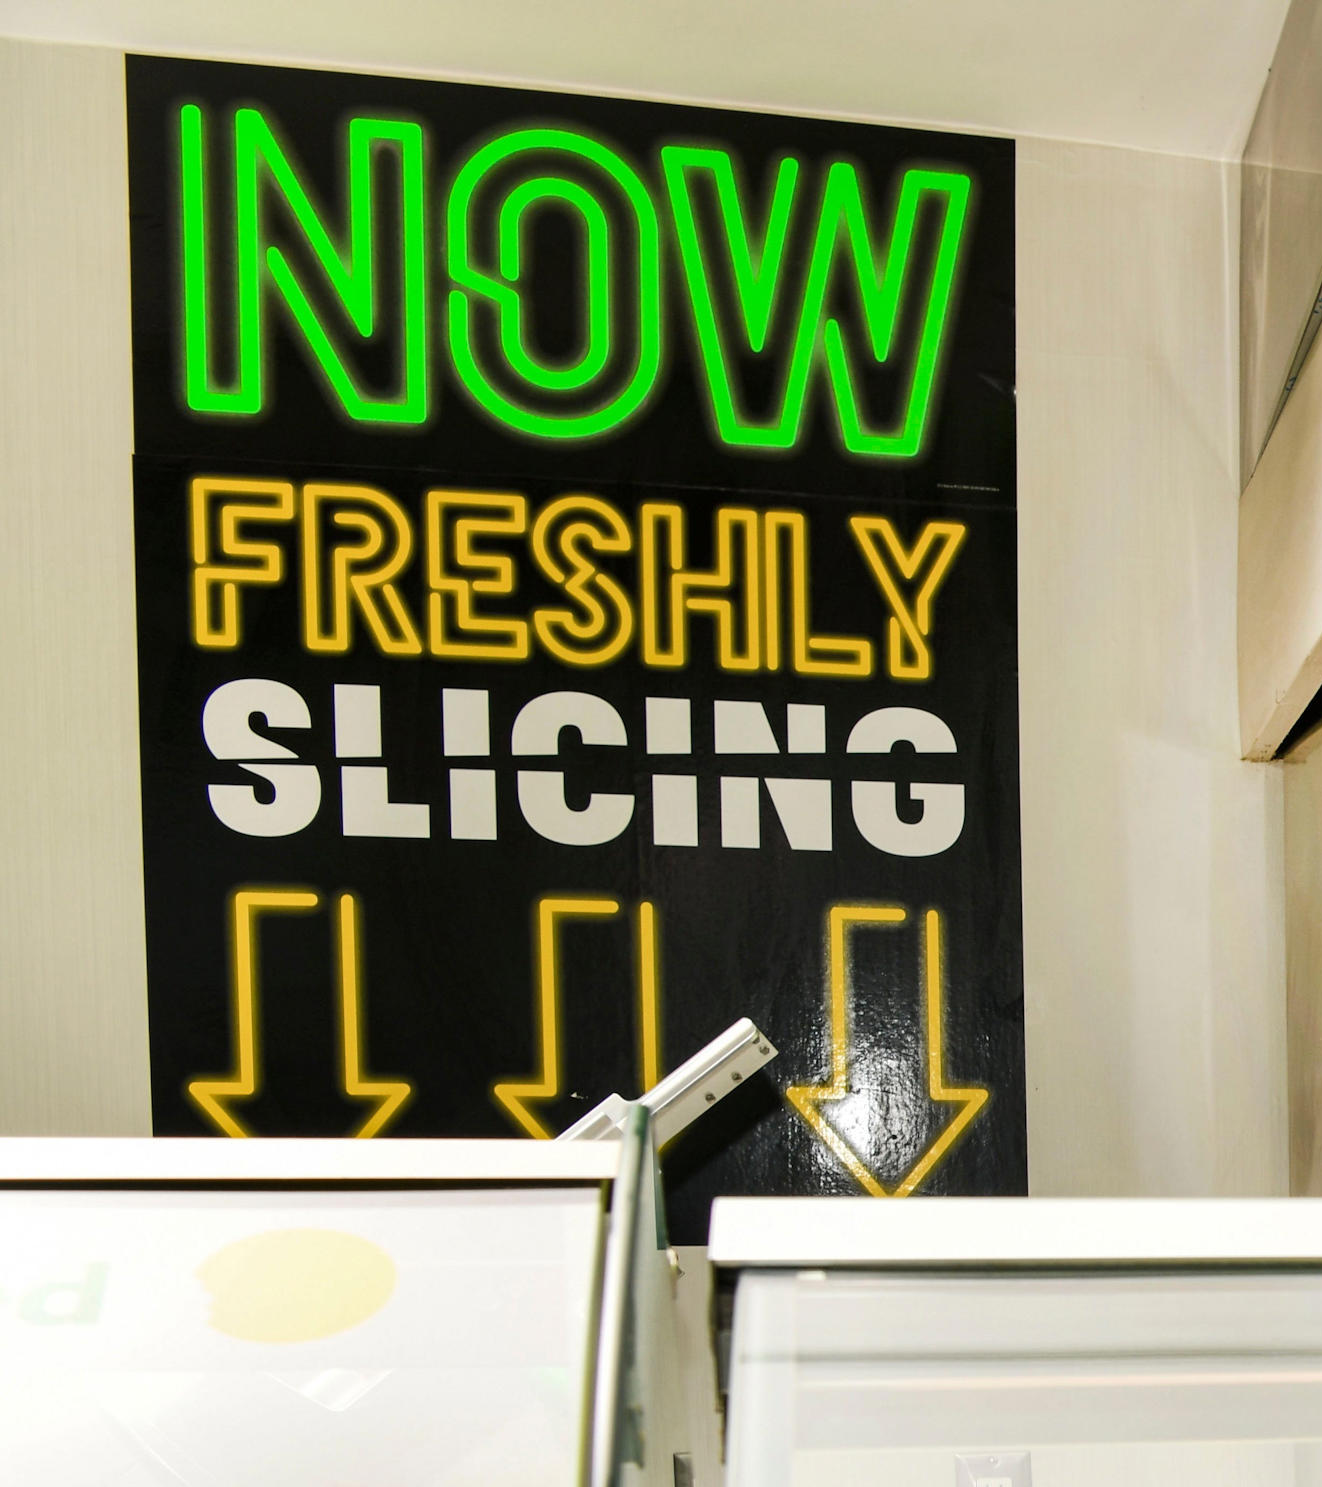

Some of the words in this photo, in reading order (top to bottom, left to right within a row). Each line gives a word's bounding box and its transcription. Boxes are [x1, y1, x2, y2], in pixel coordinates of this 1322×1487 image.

[181, 104, 970, 456] NOW
[191, 478, 966, 679] FRESHLY
[202, 677, 965, 858] SLICING
